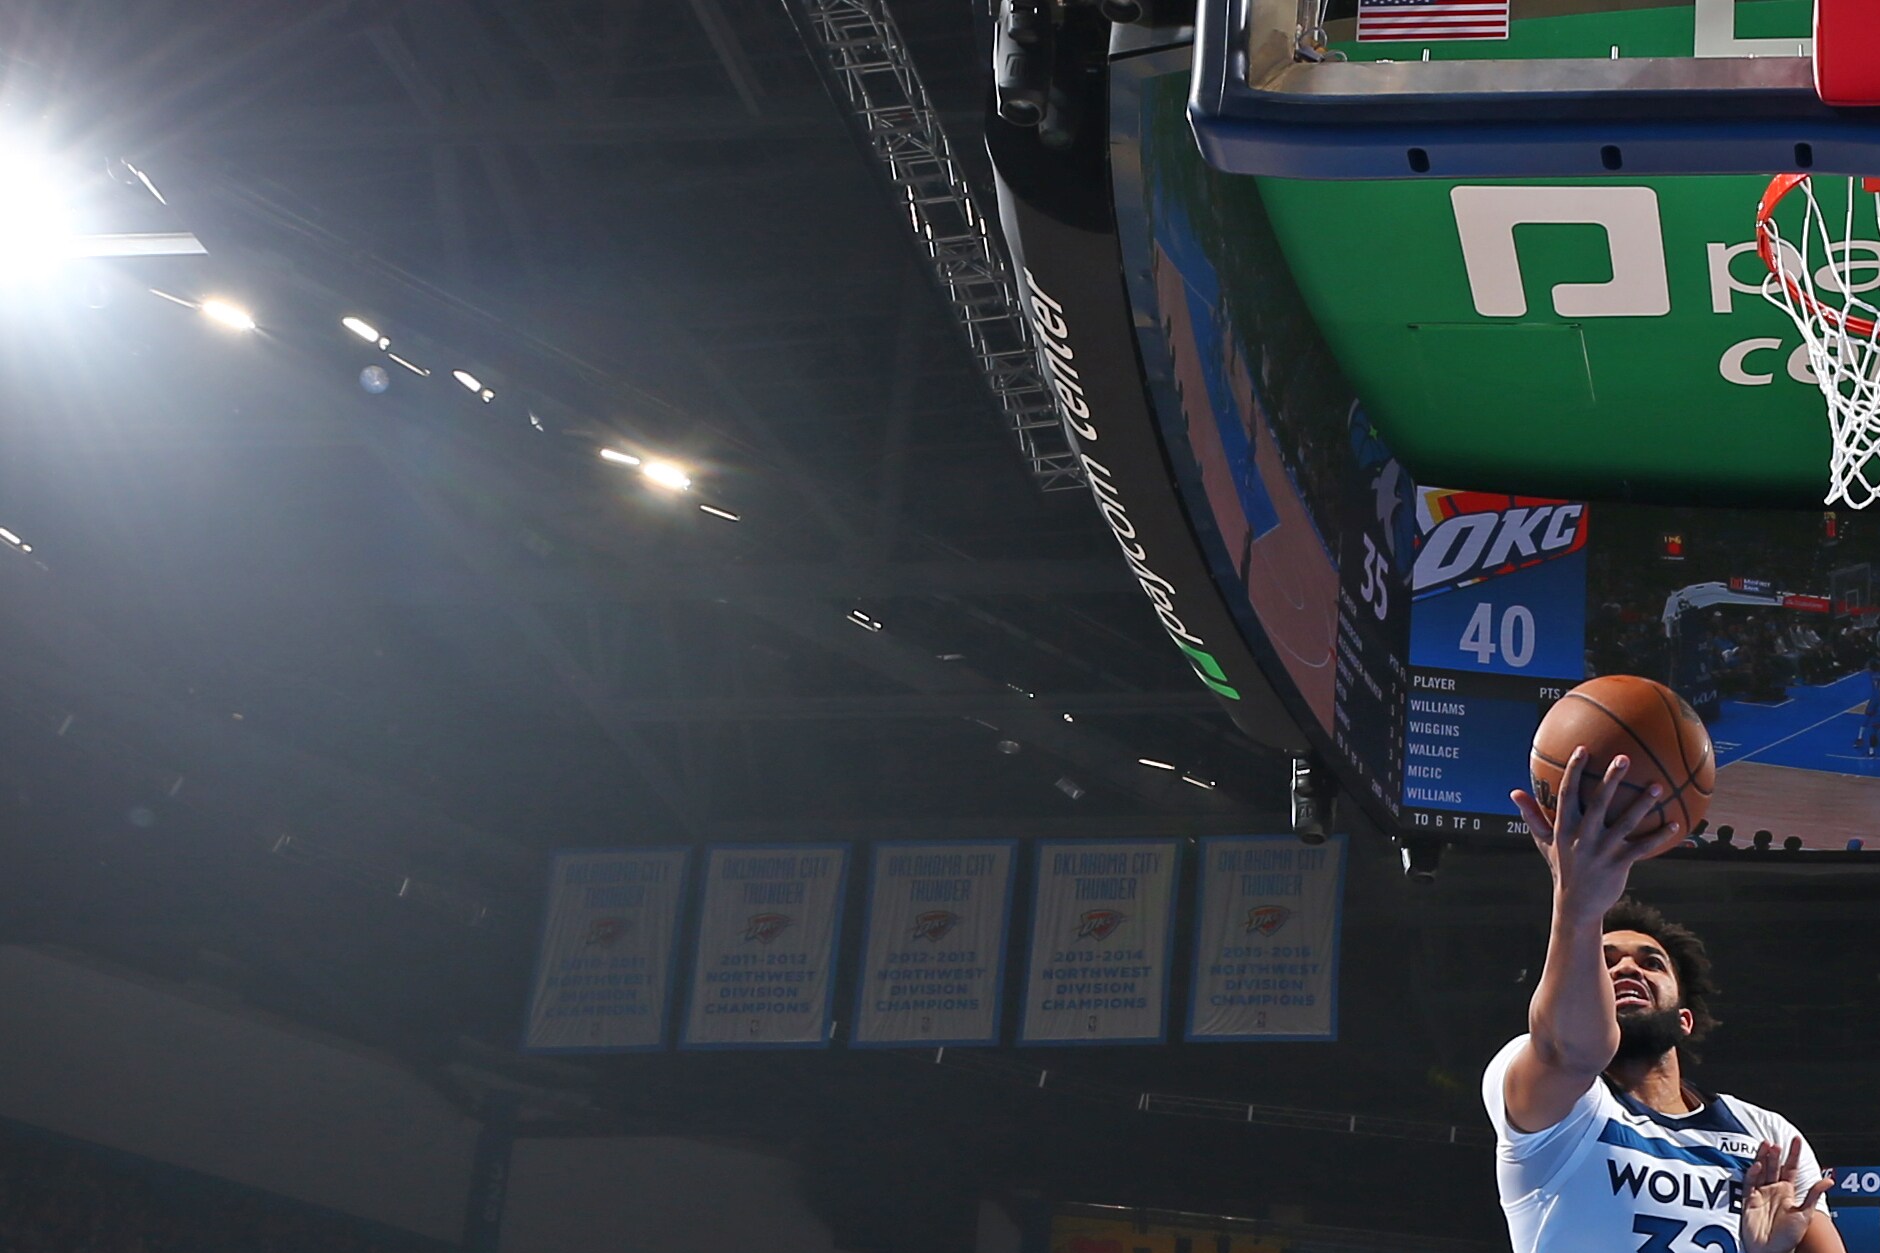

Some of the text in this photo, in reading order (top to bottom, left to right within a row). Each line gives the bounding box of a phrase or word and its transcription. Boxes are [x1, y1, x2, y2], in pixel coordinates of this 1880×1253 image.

[1023, 267, 1204, 645] paycom center
[1413, 504, 1583, 590] OKC
[1361, 532, 1390, 620] 35
[1459, 603, 1536, 668] 40
[1413, 675, 1560, 700] PLAYER PTS
[1410, 699, 1466, 716] WILLIAMS
[1409, 721, 1460, 738] WIGGINS
[1408, 743, 1460, 760] WALLACE
[1407, 764, 1442, 780] MICIC
[1406, 787, 1463, 804] WILLIAMS
[1414, 813, 1530, 834] TO 6 TF 0 2ND
[1131, 852, 1162, 874] CITY
[1074, 877, 1137, 900] THUNDER
[888, 951, 977, 964] 2012-2013
[1054, 950, 1145, 963] 2013-2014
[706, 970, 817, 982] NORTHWEST
[877, 968, 987, 981] NORTHWEST
[1042, 966, 1152, 979] NORTHWEST
[1210, 963, 1319, 976] NORTHWEST
[719, 986, 798, 998] DIVISION
[890, 983, 968, 996] DIVISION
[1056, 982, 1136, 994] DIVISION
[1225, 979, 1304, 991] DIVISION
[705, 1002, 811, 1015] CHAMPIONS
[875, 999, 980, 1012] CHAMPIONS
[1041, 997, 1147, 1011] CHAMPIONS
[1210, 995, 1316, 1007] CHAMPIONS
[1607, 1159, 1744, 1215] WOLVE
[1841, 1172, 1880, 1193] 40
